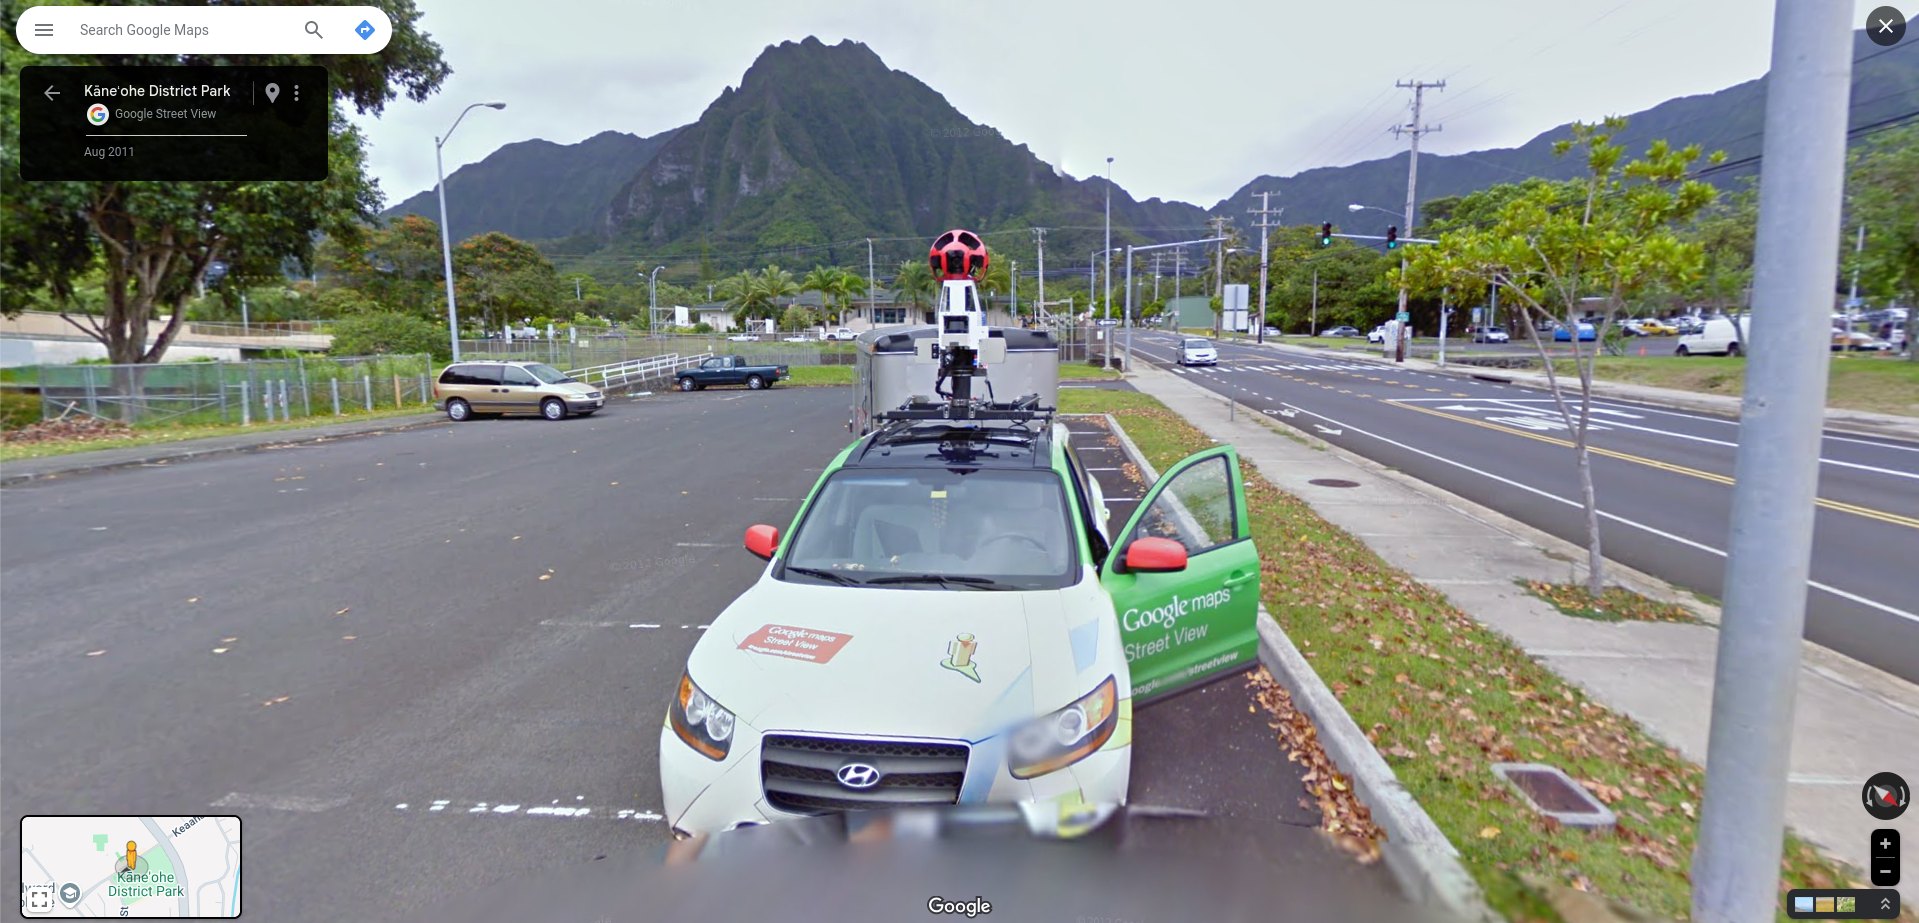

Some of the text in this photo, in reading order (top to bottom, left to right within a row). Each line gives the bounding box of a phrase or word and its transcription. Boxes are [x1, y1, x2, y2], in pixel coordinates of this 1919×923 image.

[1123, 588, 1231, 632] Google maps
[763, 636, 819, 650] Street View
[768, 626, 837, 643] Google maps
[1124, 624, 1208, 664] Street View
